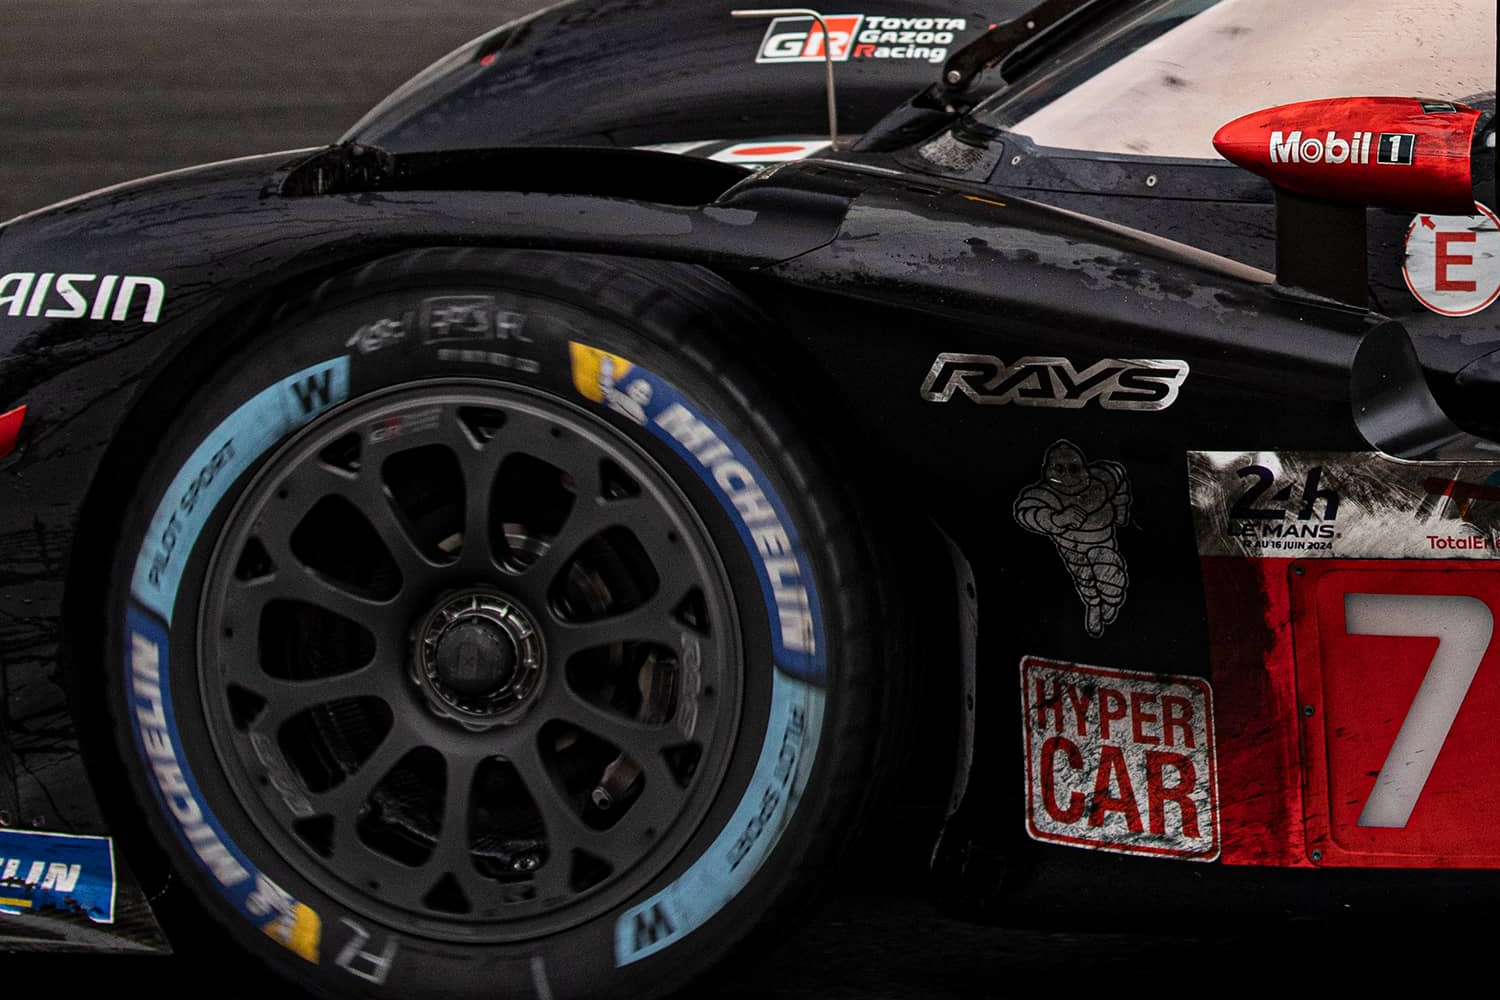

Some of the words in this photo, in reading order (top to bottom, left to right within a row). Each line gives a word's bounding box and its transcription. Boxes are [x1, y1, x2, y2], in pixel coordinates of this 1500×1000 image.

[762, 32, 851, 58] GR
[859, 30, 954, 45] GAZOO
[866, 16, 967, 30] TOYOTA
[852, 45, 949, 64] Racing
[1269, 131, 1372, 164] Mobil
[1387, 135, 1404, 163] 1
[1435, 231, 1477, 291] E
[0, 272, 165, 323] AISIN
[291, 368, 335, 414] W
[924, 356, 1187, 408] RAYS
[148, 515, 180, 588] PILOT
[181, 438, 237, 514] SPORT
[1227, 523, 1258, 537] LE
[1262, 523, 1336, 539] MANS
[1284, 541, 1305, 550] JUIN
[1307, 542, 1333, 550] 2024
[1034, 677, 1196, 749] HYPER
[1343, 592, 1494, 828] 7
[1038, 737, 1202, 840] CAR
